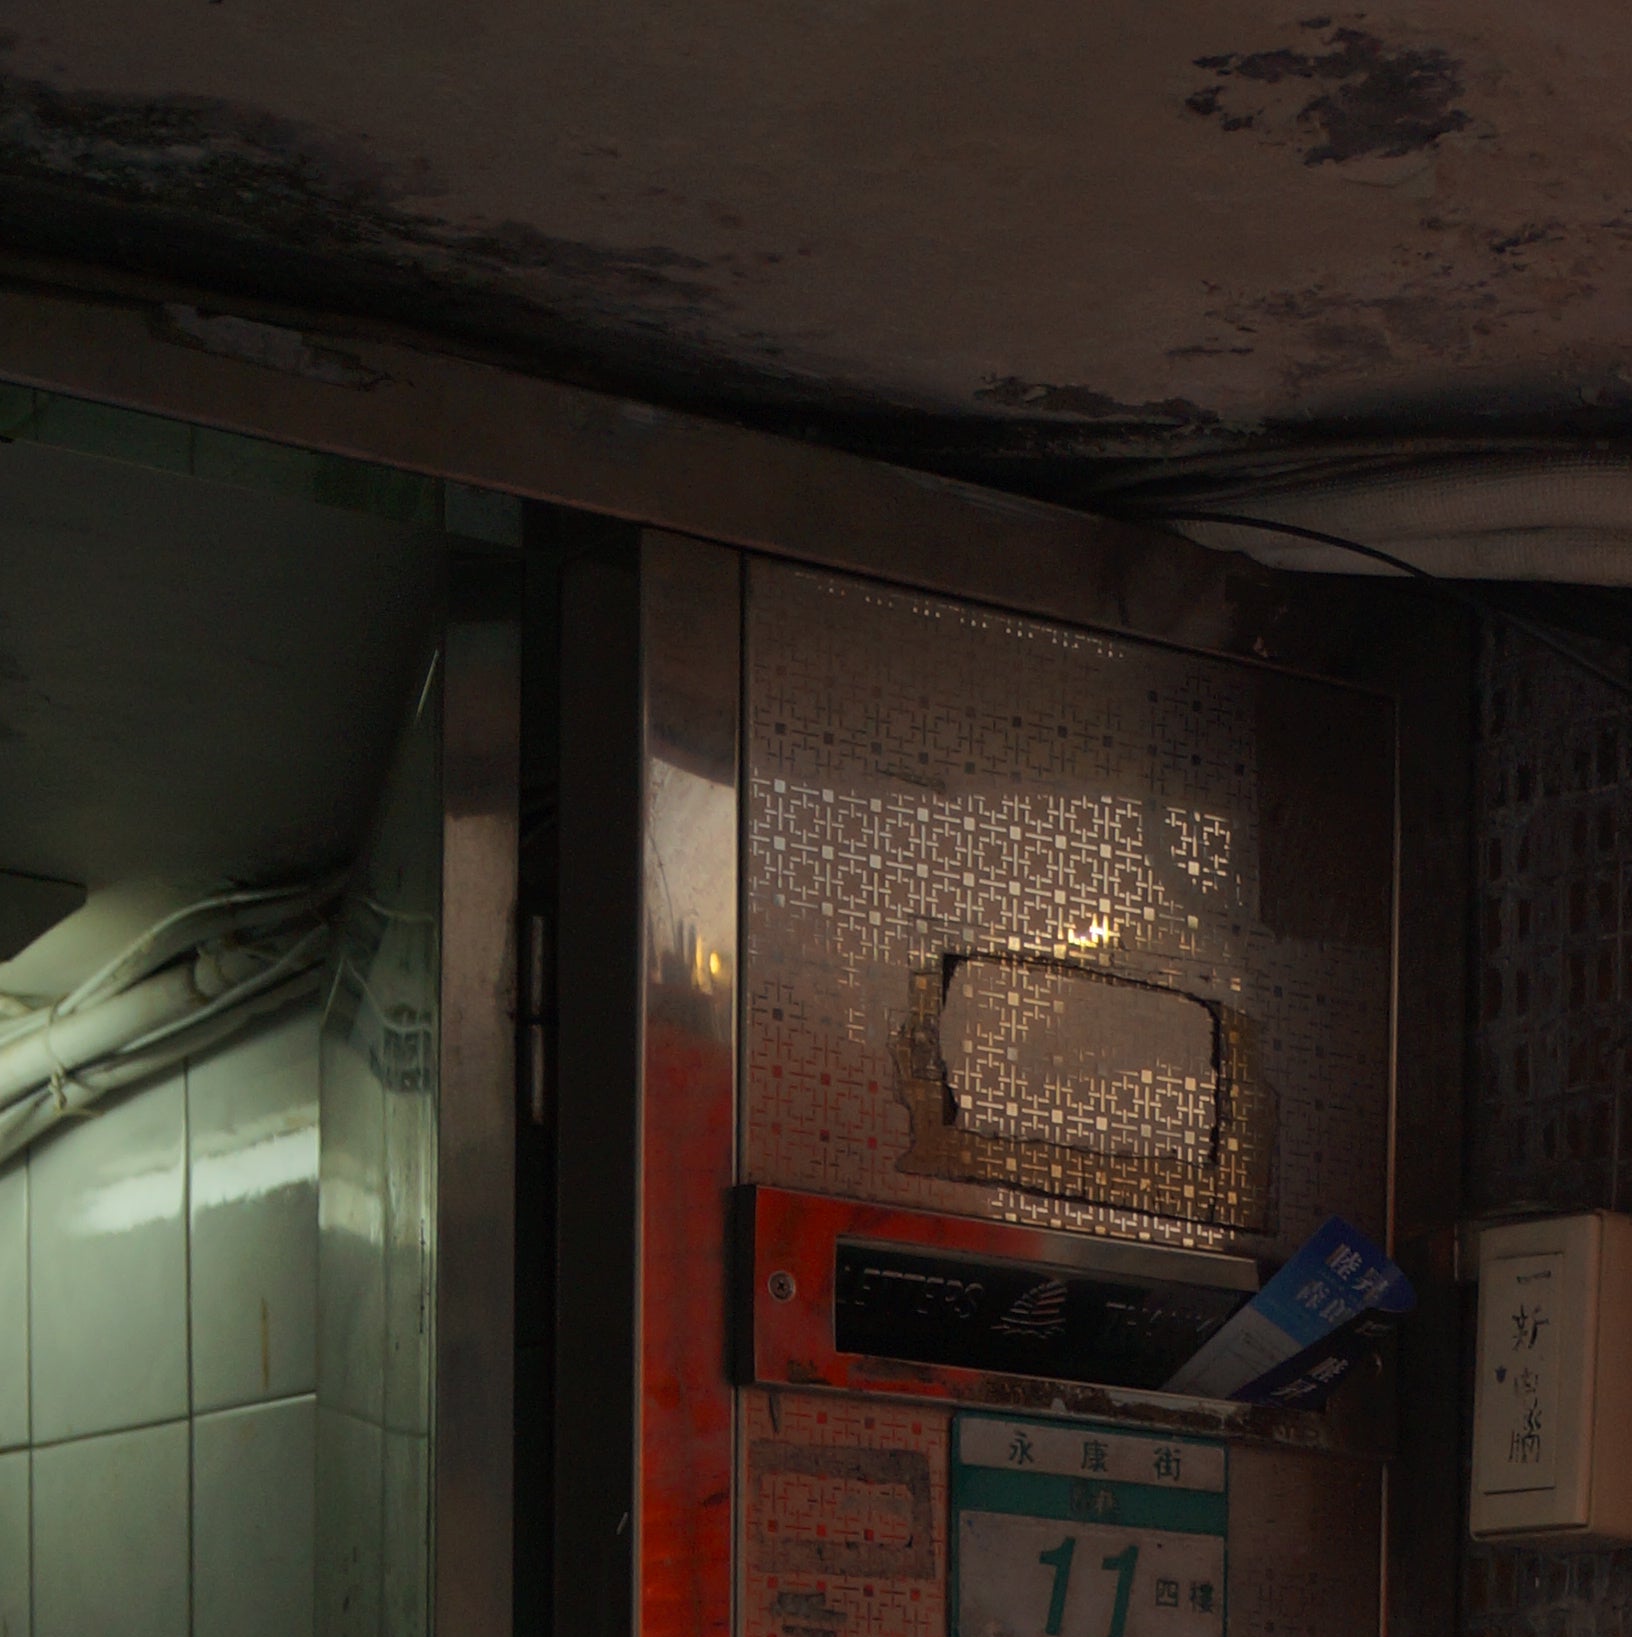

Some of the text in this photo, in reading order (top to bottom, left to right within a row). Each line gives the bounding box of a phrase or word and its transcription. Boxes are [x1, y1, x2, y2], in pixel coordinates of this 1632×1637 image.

[1008, 1431, 1182, 1482] 永康街
[1155, 1578, 1217, 1614] 四樓
